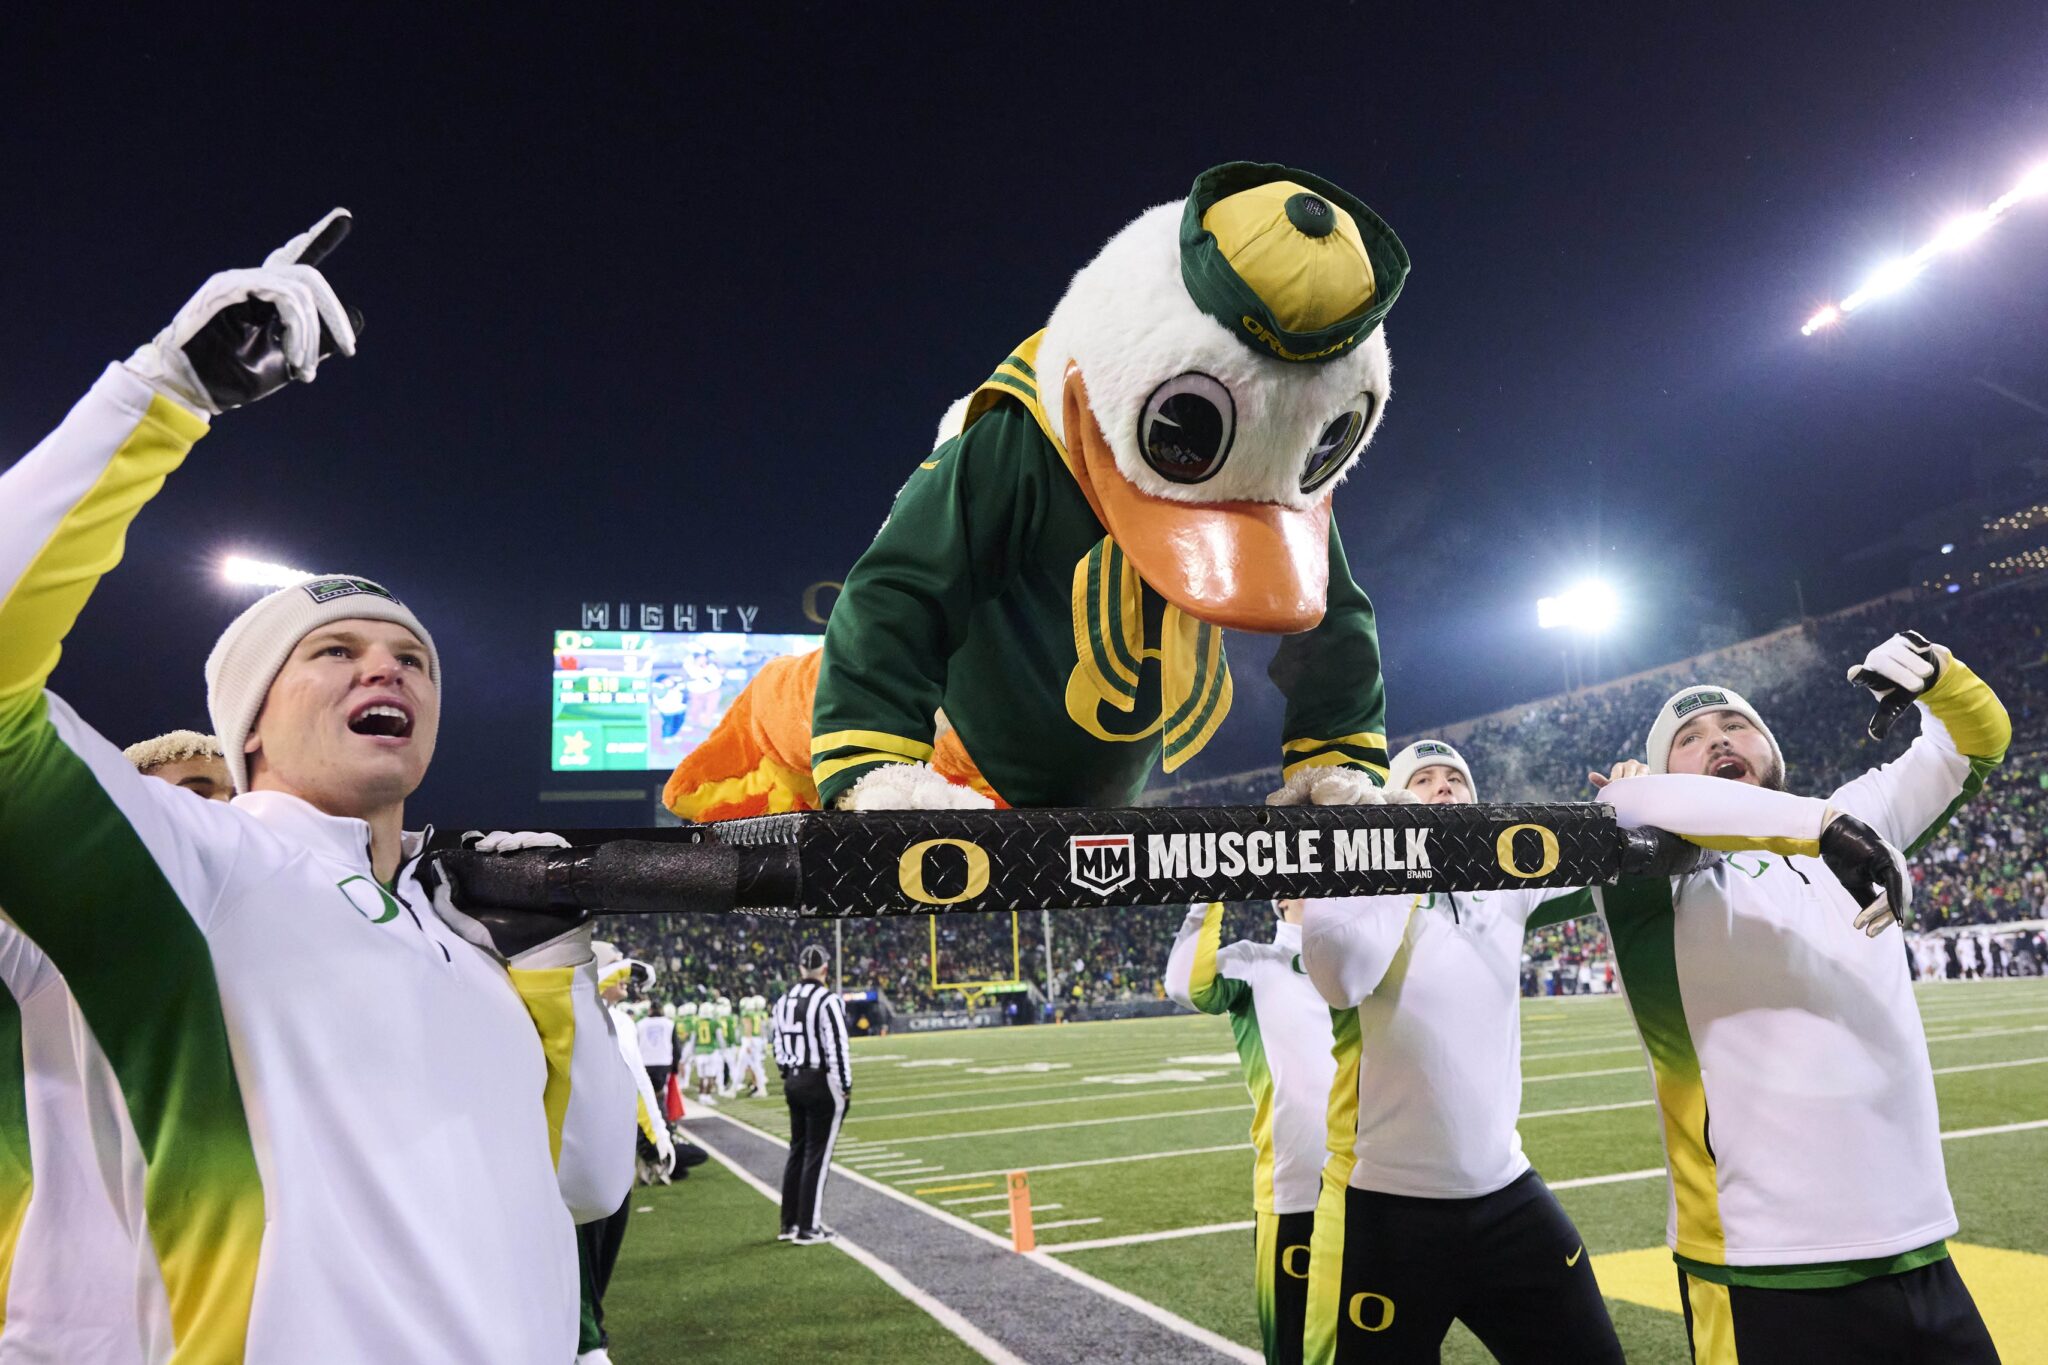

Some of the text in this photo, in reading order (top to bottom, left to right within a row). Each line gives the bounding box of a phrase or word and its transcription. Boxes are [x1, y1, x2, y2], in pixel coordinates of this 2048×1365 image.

[581, 602, 759, 632] MIGHTY
[897, 838, 990, 905] O
[1147, 830, 1323, 880] MUSCLE
[1333, 828, 1432, 871] MILK
[1496, 823, 1559, 879] O
[1406, 870, 1433, 879] BRAND
[1349, 1291, 1395, 1332] O
